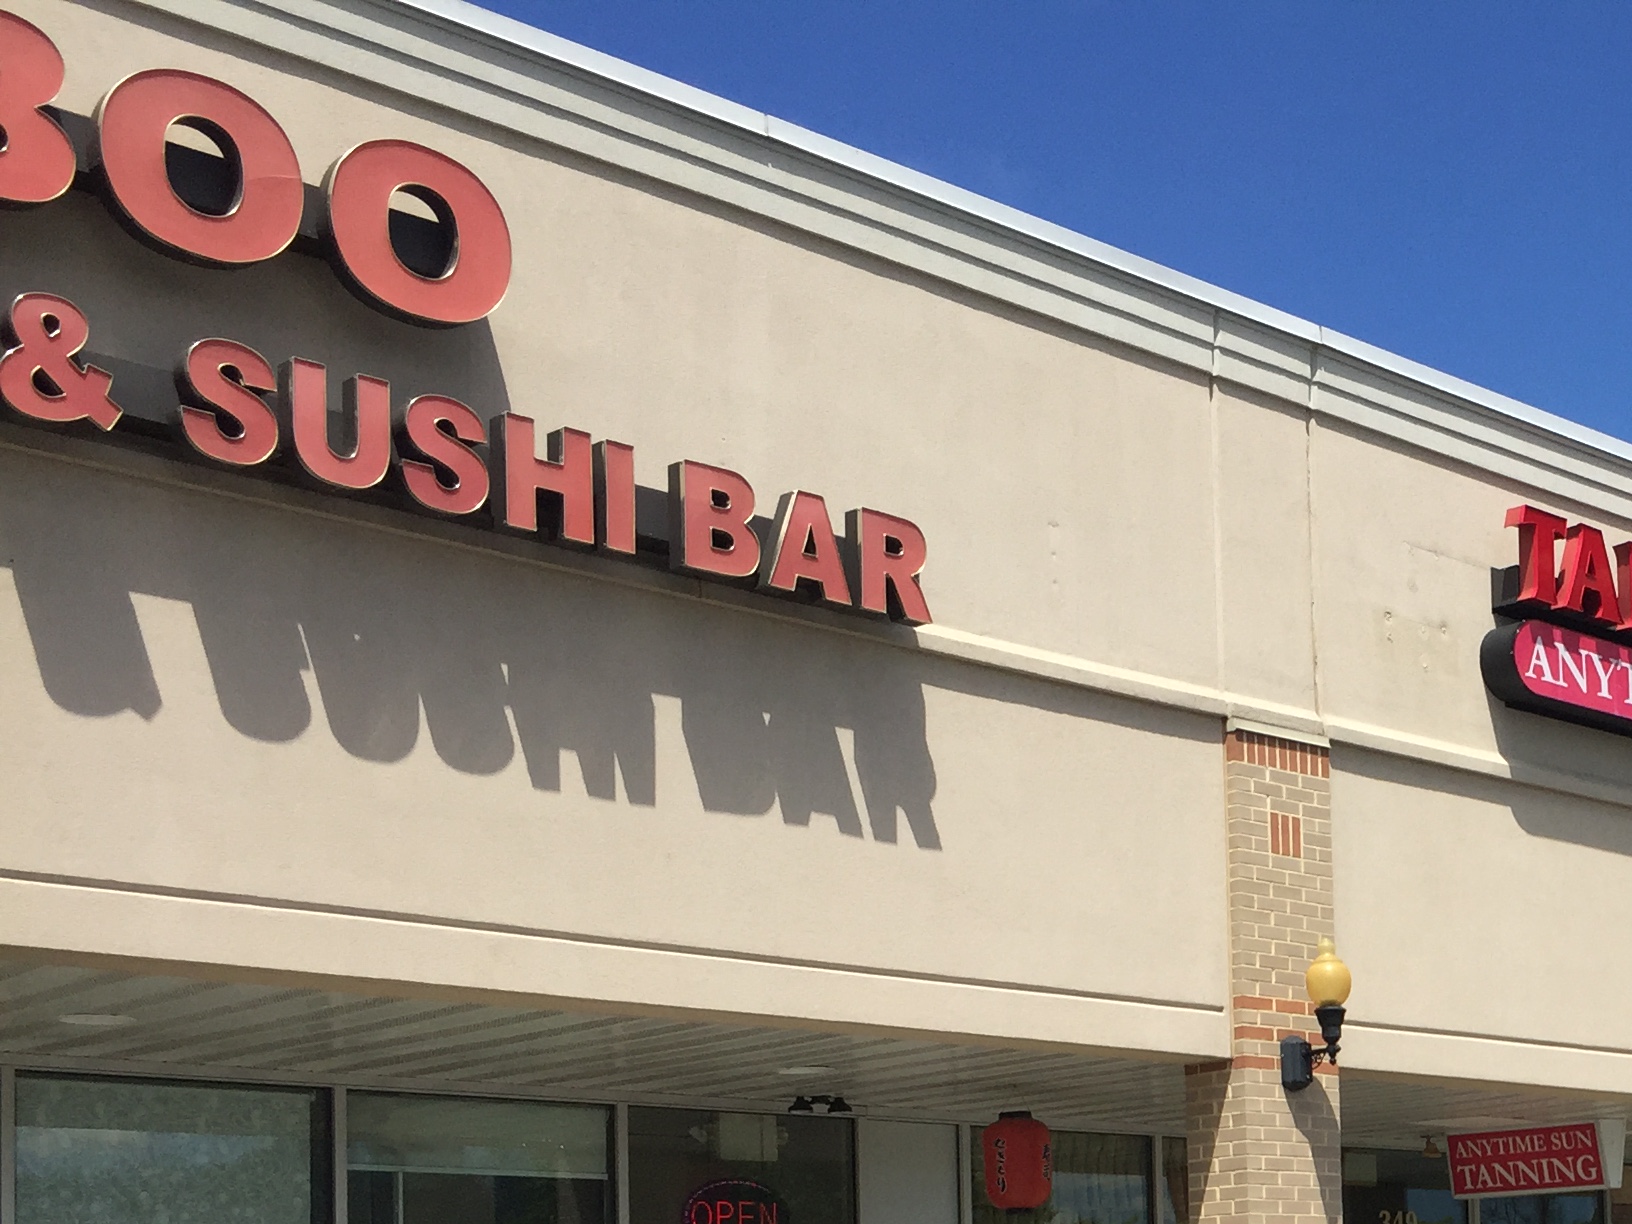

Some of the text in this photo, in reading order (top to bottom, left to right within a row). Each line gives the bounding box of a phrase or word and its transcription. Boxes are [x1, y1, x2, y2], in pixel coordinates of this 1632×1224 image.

[0, 291, 933, 624] & SUSHI BAR
[1456, 1129, 1593, 1159] ANYTIME SUN
[1456, 1154, 1598, 1191] TANNING
